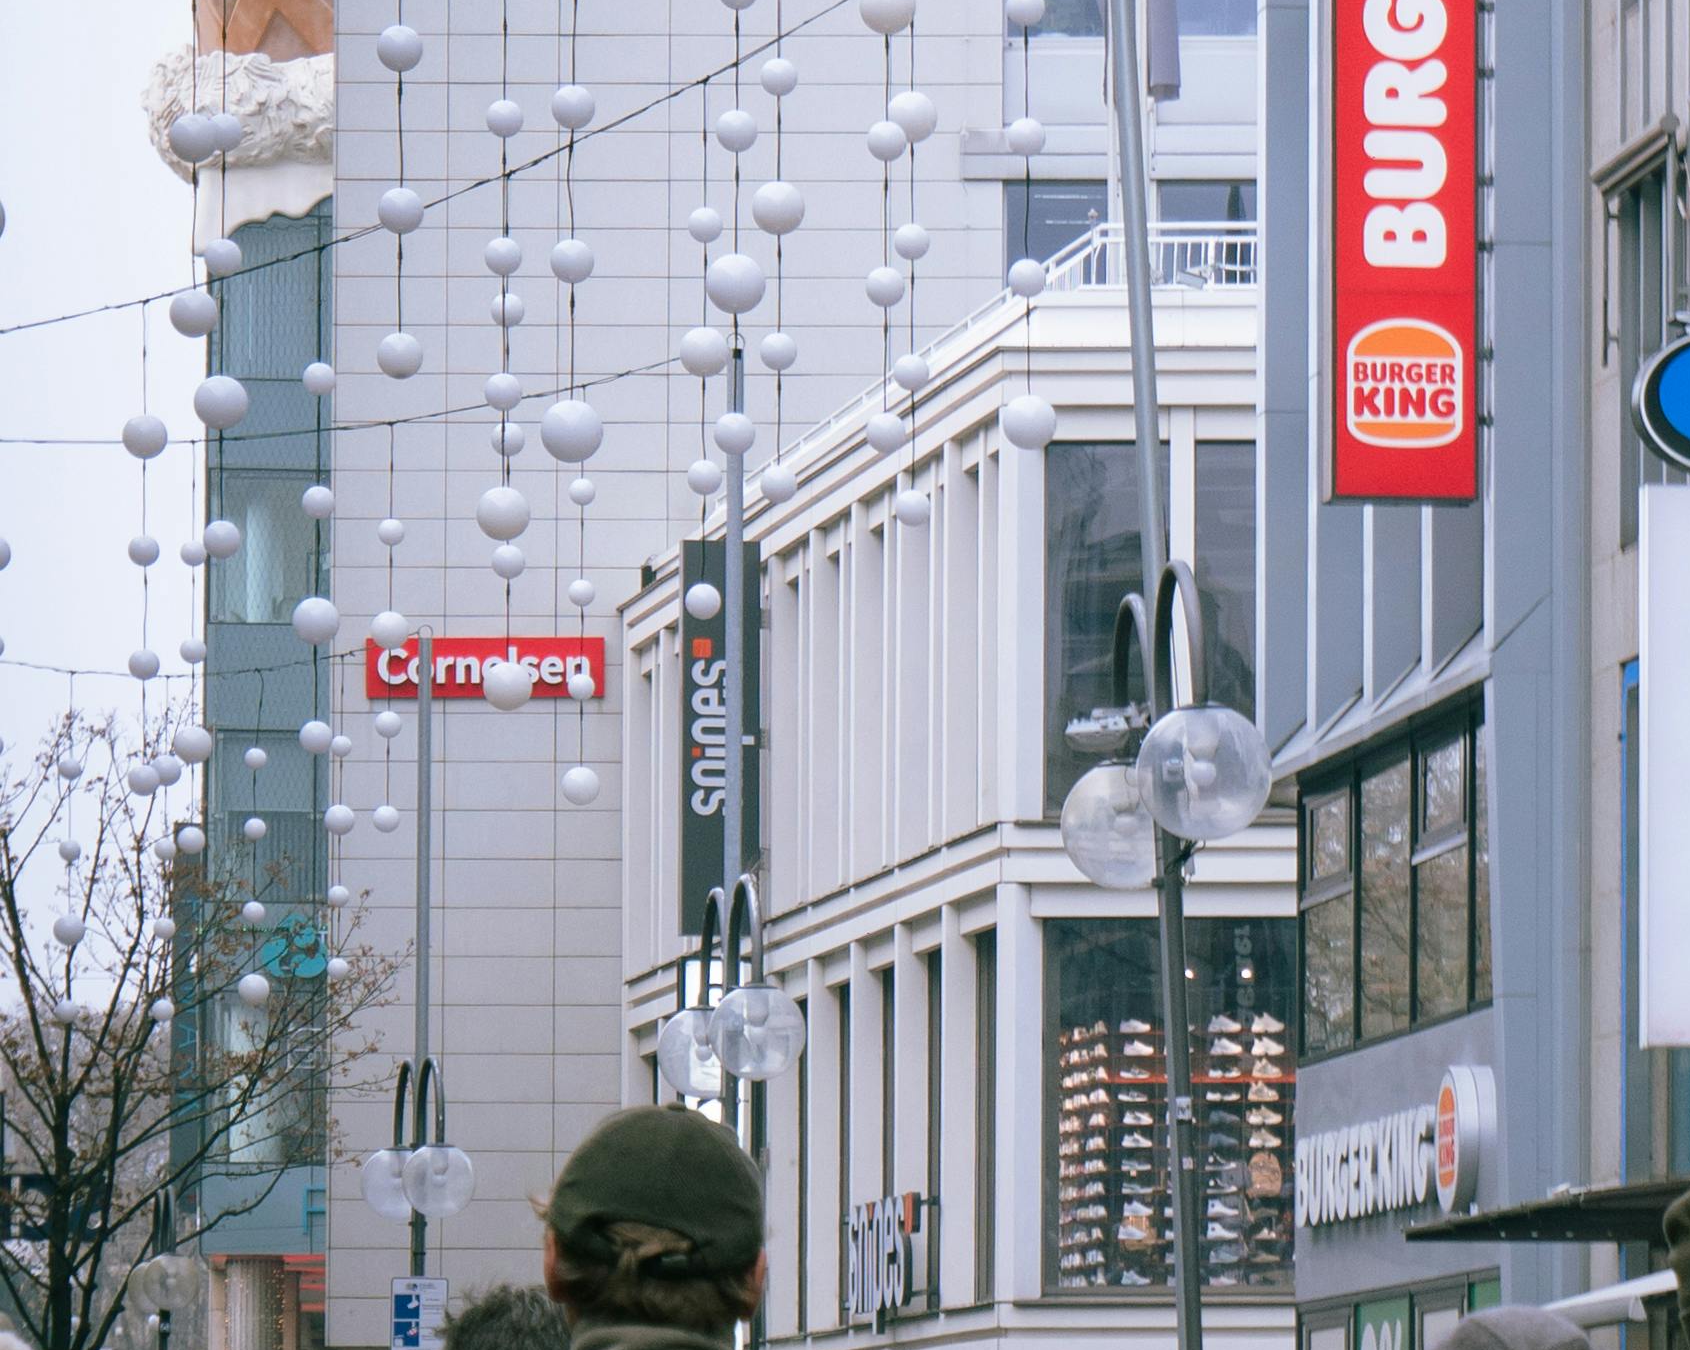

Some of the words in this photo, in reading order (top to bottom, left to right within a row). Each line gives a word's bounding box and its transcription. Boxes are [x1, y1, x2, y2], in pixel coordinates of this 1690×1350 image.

[1353, 361, 1456, 385] BURGER
[1353, 386, 1456, 419] KING
[1295, 1122, 1375, 1228] BURGER
[1376, 1105, 1431, 1213] KING
[848, 1196, 905, 1335] snipes
